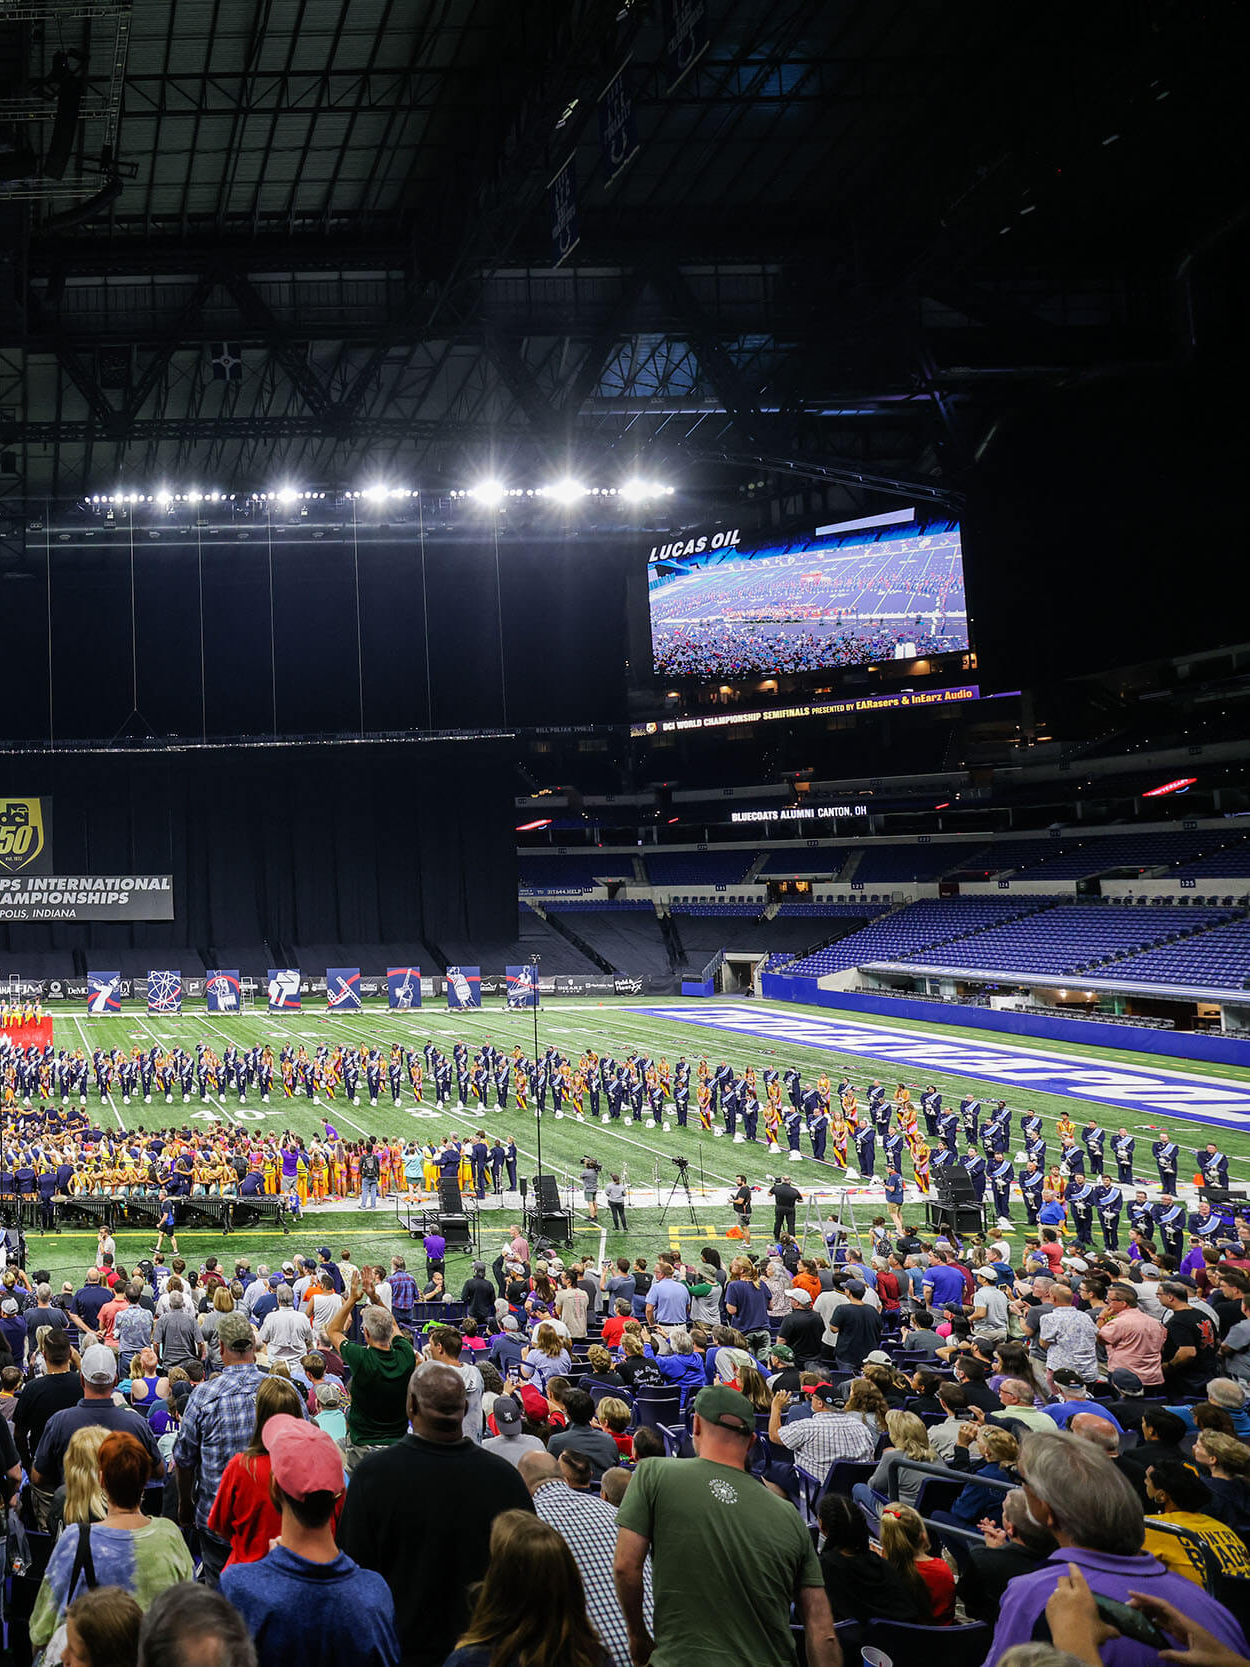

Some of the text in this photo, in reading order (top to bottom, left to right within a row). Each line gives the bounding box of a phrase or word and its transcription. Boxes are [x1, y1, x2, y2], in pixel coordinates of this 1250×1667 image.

[649, 529, 741, 562] LUCAS OIL
[676, 718, 702, 730] WORLD
[703, 712, 762, 727] CHAMPIONSHIP
[762, 706, 810, 721] SEMIFINALS
[812, 704, 845, 714] PRESENTED
[846, 703, 854, 712] BY
[856, 696, 899, 710] EARasers
[901, 694, 910, 705] &
[912, 692, 942, 704] InEarz
[944, 689, 972, 702] Audio
[731, 806, 867, 822] BLUECOATS ALUMNI CANTON, OH
[26, 878, 170, 891] INTERNATIONAL
[32, 908, 76, 918] INDIANA
